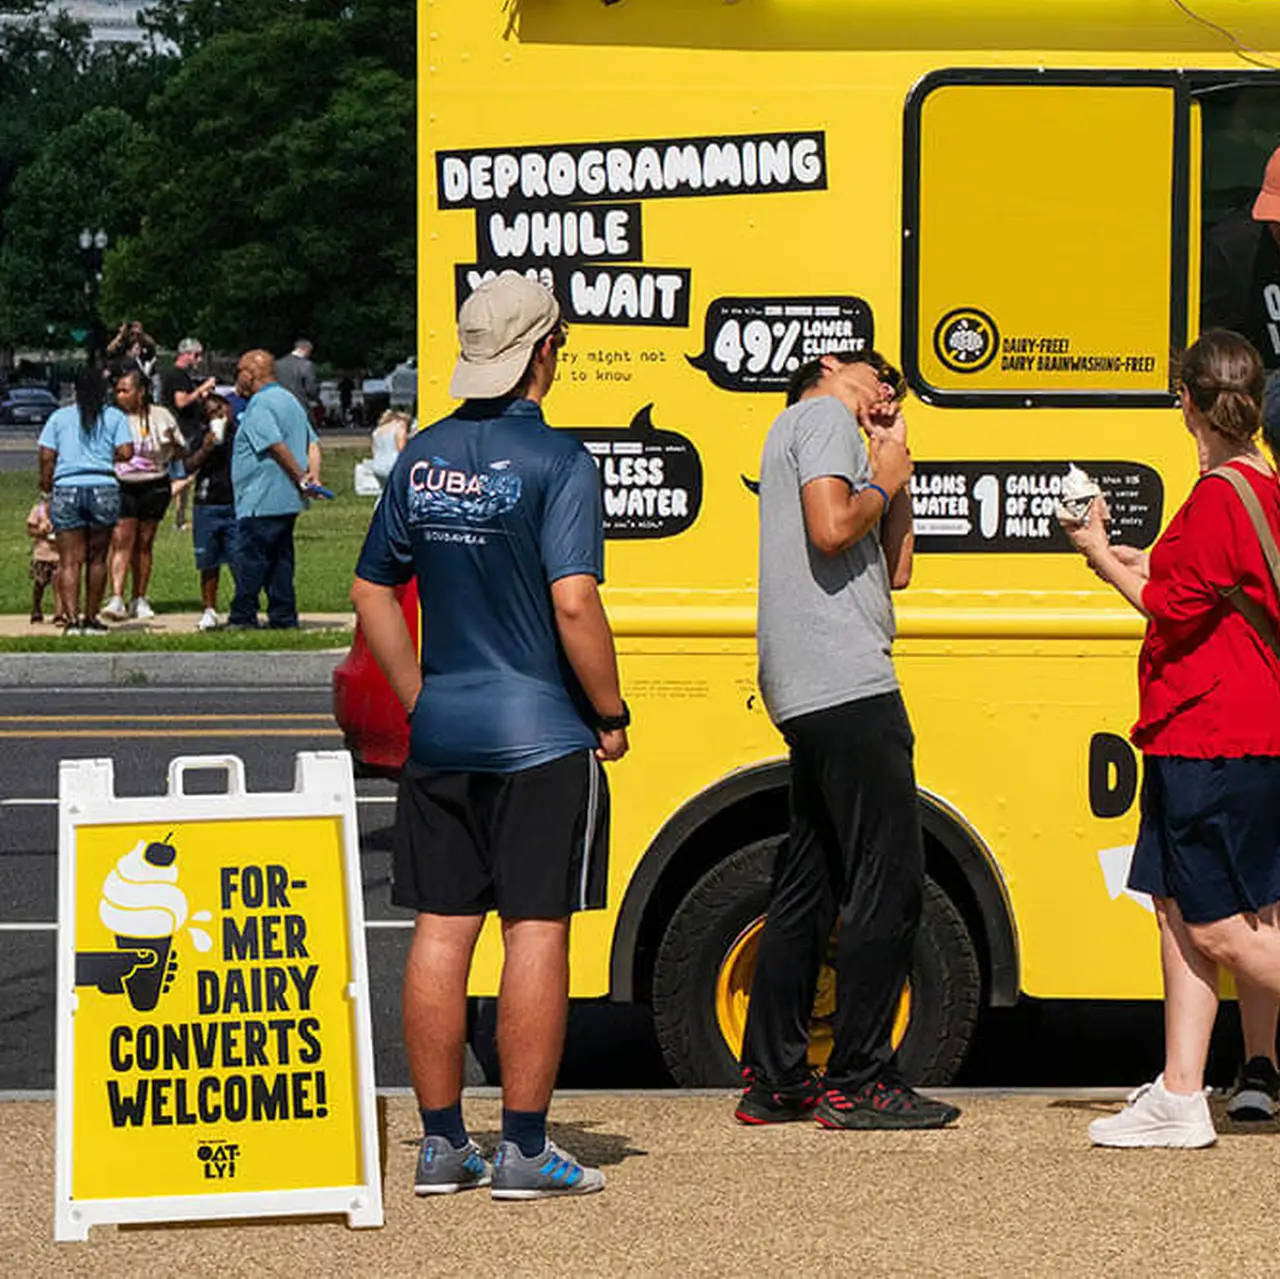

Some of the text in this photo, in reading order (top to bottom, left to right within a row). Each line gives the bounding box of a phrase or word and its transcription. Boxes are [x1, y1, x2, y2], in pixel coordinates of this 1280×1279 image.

[442, 139, 822, 201] DEPROGRAMMING
[489, 210, 630, 257] WHILE
[571, 271, 683, 319] WAIT
[802, 320, 853, 337] LOWER
[587, 350, 631, 364] might
[640, 351, 667, 363] not
[714, 319, 800, 373] 49%
[571, 370, 587, 381] to
[596, 370, 632, 381] know
[1002, 356, 1034, 371] DAIRY
[410, 461, 482, 495] CUBA
[604, 457, 664, 486] LESS
[1005, 475, 1063, 495] GALLO
[604, 488, 688, 517] WATER
[912, 496, 969, 516] WATER
[973, 474, 999, 539] 1
[1005, 496, 1028, 516] OF
[1005, 518, 1051, 537] MILK
[220, 865, 307, 910] FOR-
[222, 914, 308, 961] MER
[198, 964, 319, 1016] DAIRY
[110, 1018, 322, 1072] CONVERTS
[107, 1071, 328, 1127] WELCOME!
